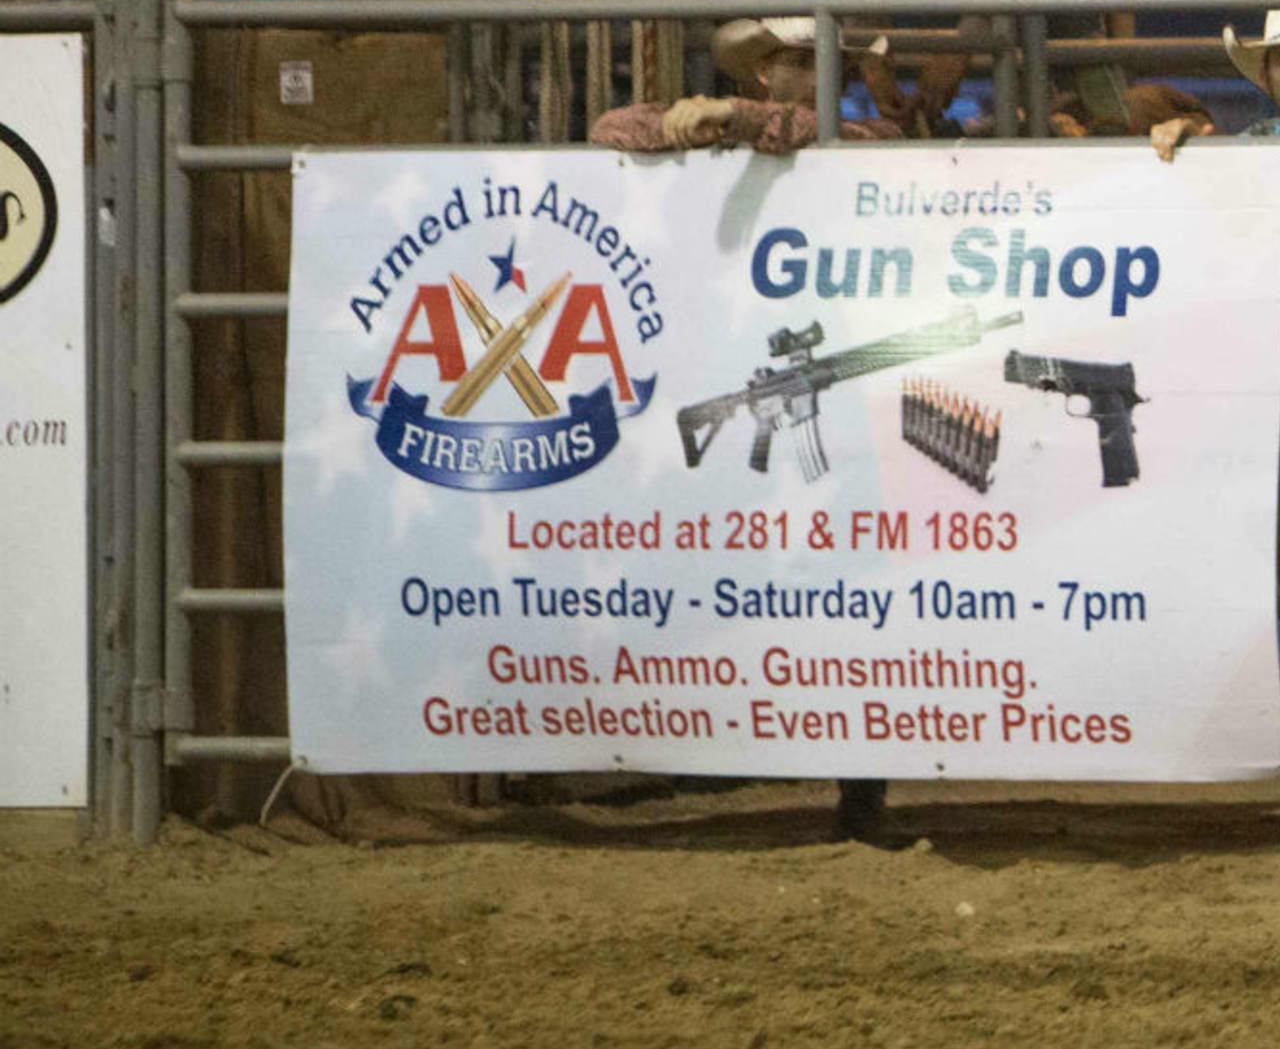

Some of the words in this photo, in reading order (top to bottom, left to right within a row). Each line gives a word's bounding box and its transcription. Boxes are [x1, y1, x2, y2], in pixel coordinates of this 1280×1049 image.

[856, 181, 1054, 217] Bulverde's
[349, 189, 472, 333] Armed
[483, 178, 521, 218] in
[532, 181, 664, 344] America
[751, 227, 914, 299] Gun
[948, 226, 1161, 317] Shop
[396, 422, 596, 474] FIREARMS
[507, 511, 661, 551] Located
[675, 515, 711, 551] at
[725, 511, 790, 551] 281
[807, 512, 836, 552] &
[850, 512, 909, 551] FM
[925, 512, 1019, 552] 1863
[400, 577, 501, 626] Open
[513, 577, 675, 628] Tuesday
[714, 578, 893, 630] Saturday
[910, 580, 1016, 620] 10am
[1059, 581, 1148, 631] 7pm
[487, 646, 599, 687] Guns.
[613, 648, 749, 688] Ammo.
[763, 649, 1038, 699] Gunsmithing.
[422, 697, 531, 738] Great
[541, 701, 713, 740] selection
[752, 700, 850, 742] Even
[865, 703, 988, 745] Better
[1001, 705, 1133, 747] Prices
